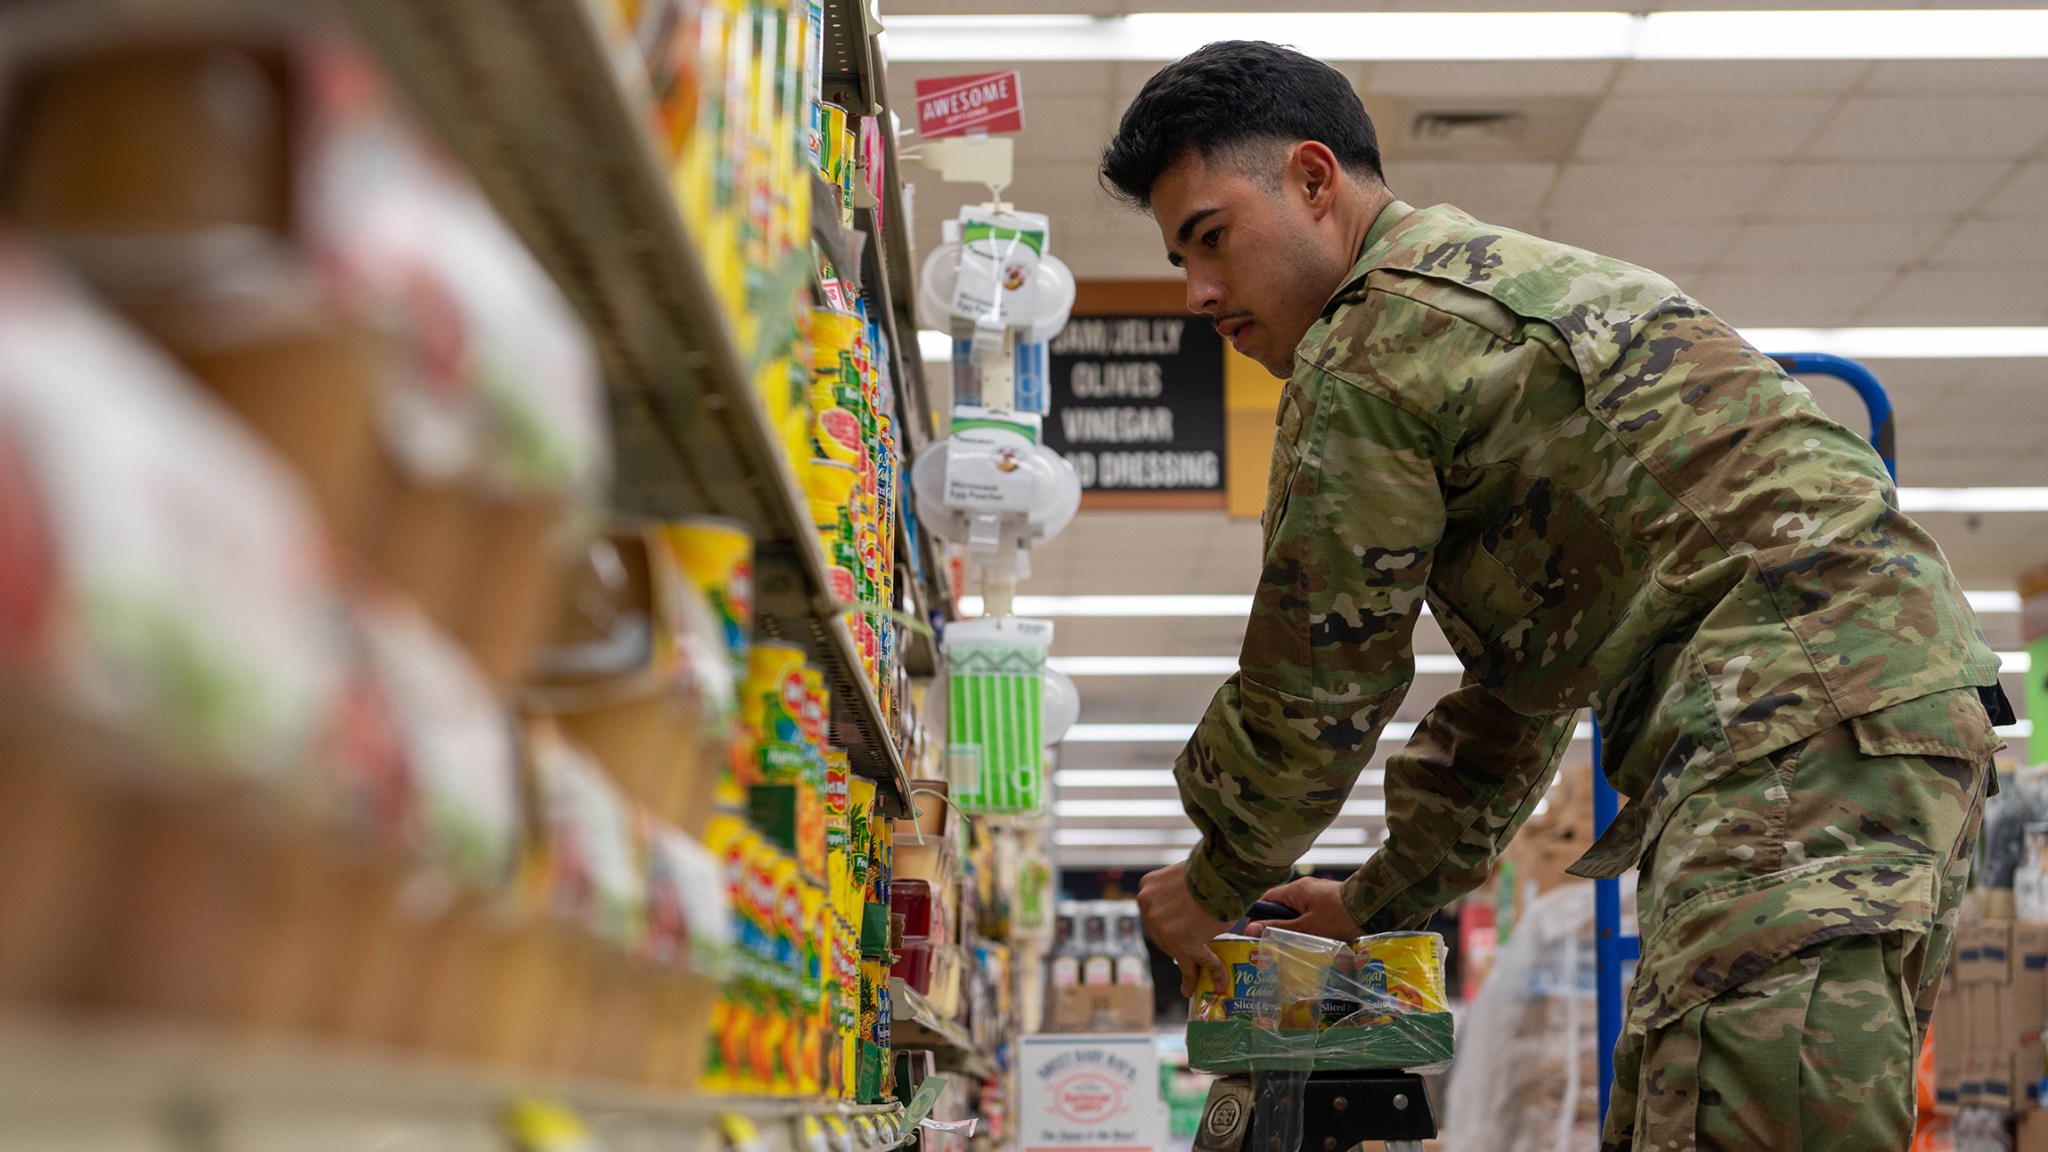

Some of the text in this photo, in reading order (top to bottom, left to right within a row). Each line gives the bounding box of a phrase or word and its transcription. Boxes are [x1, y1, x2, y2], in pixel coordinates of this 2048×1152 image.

[922, 79, 1008, 122] AWESOME
[1070, 361, 1163, 399] OLIVES
[1061, 406, 1174, 443] VINEGAR
[1098, 450, 1219, 488] DRESSING
[1235, 970, 1254, 985] No
[1233, 1001, 1260, 1010] Sliced
[1321, 1002, 1346, 1012] Sliced
